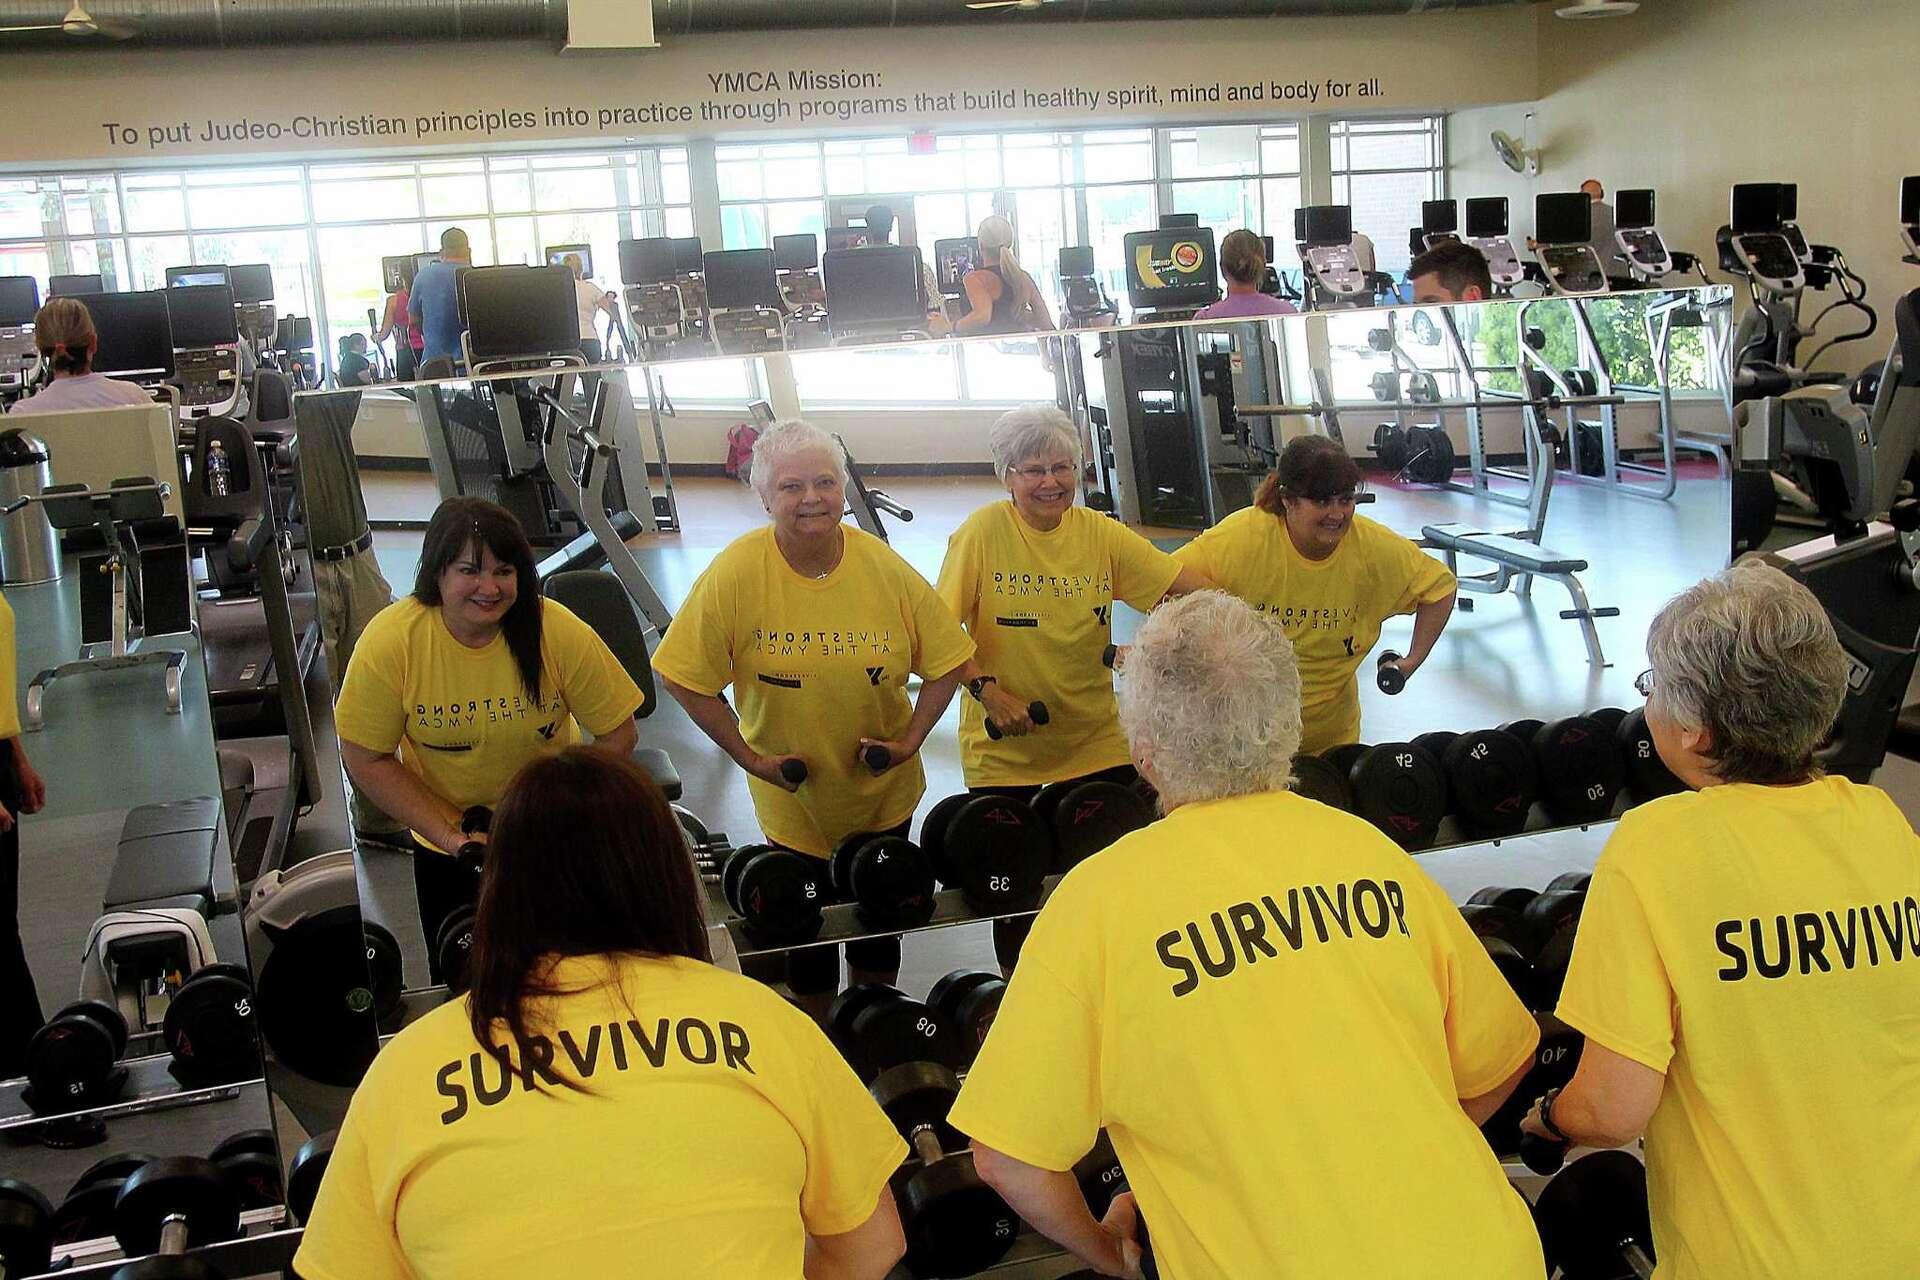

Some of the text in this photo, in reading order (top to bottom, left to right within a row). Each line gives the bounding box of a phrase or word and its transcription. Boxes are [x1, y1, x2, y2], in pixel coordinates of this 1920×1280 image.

[102, 77, 1384, 149] To put Judeo-Christian principles into practice through programs that build healthy spirit, mind and body for all.
[708, 70, 882, 93] YMCA Mission:
[1156, 879, 1411, 997] SURVIVOR
[436, 1017, 756, 1125] SURVIVOR
